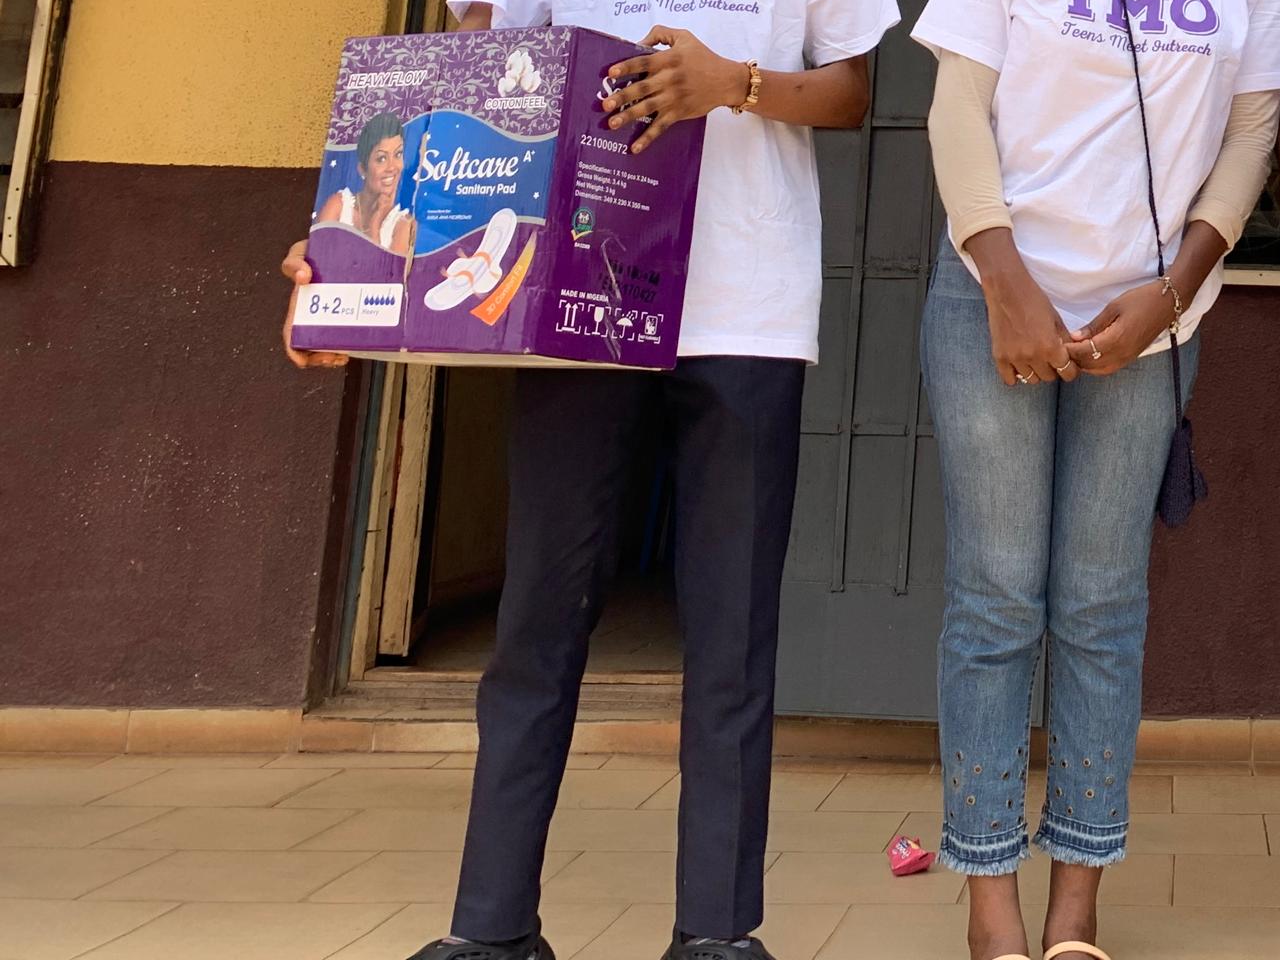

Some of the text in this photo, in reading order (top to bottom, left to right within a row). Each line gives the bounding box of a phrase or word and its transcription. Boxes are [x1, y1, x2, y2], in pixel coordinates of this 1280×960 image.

[1061, 21, 1212, 56] Teens Meet Outreach
[348, 70, 427, 88] HEAVY FLOW
[485, 97, 547, 109] COTTON FEEL
[580, 134, 628, 154] 221000972
[412, 146, 519, 191] Softcare
[456, 182, 517, 196] Sanitary Pad
[561, 289, 578, 297] MADE
[586, 293, 609, 302] NIGERIA
